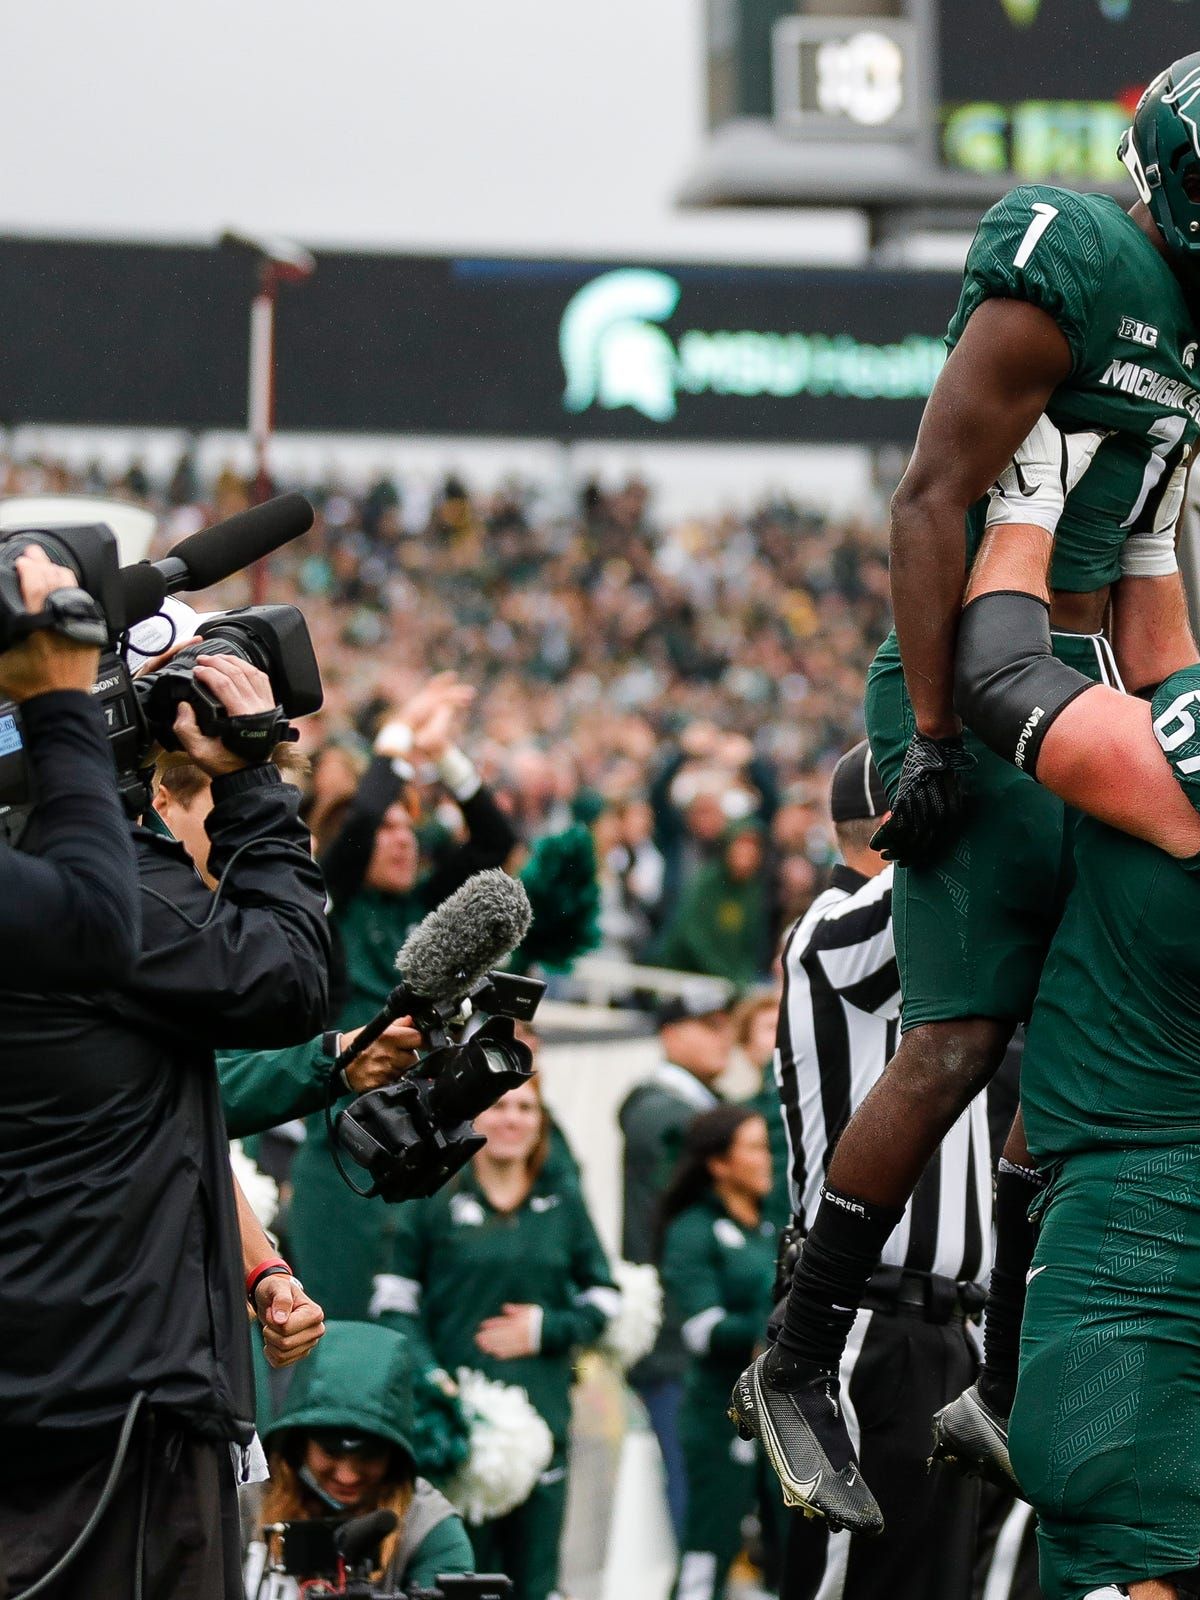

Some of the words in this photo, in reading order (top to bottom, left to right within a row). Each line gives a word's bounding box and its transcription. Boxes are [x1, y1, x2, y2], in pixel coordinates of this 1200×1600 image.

[1013, 202, 1059, 269] 1
[1099, 359, 1197, 410] MICHIGAN
[1120, 415, 1188, 528] 1
[91, 675, 120, 695] SONY
